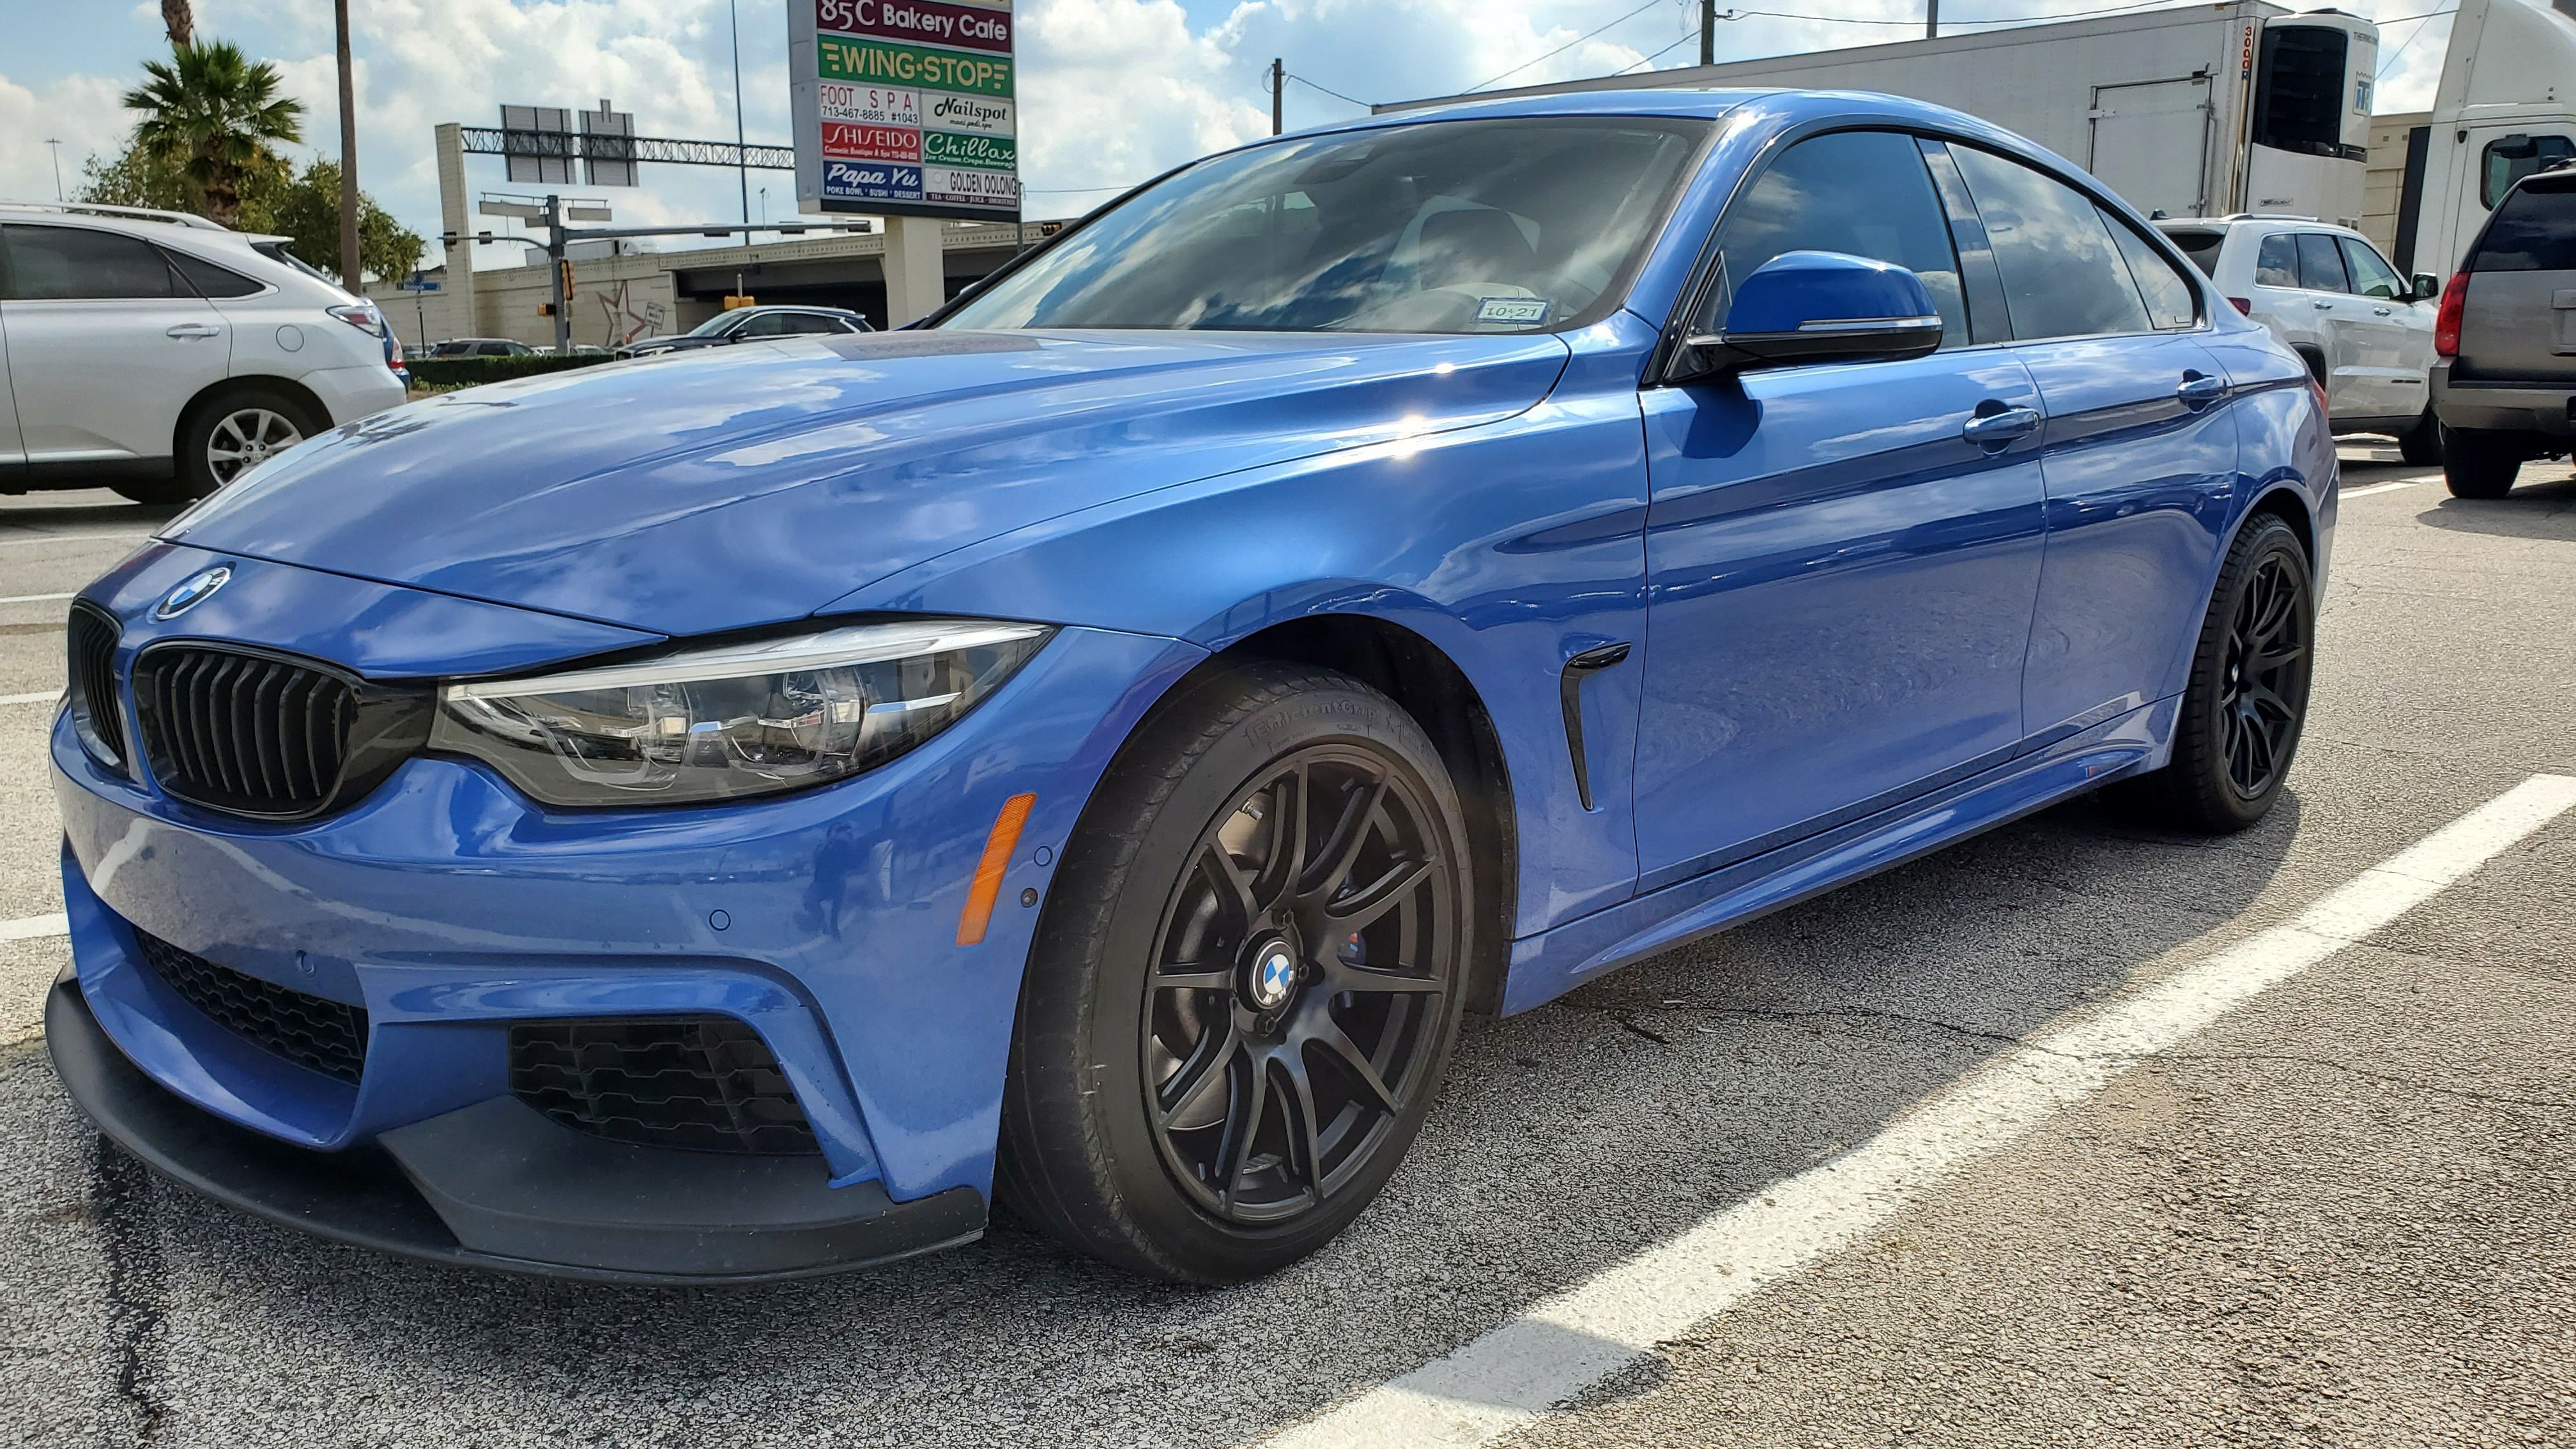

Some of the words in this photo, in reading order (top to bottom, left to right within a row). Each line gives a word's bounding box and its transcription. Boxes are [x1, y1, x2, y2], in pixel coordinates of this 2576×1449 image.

[820, 0, 875, 29] 85C
[883, 3, 954, 38] Bakery
[958, 14, 1008, 41] Cafe
[820, 85, 854, 107] FOOT
[822, 105, 885, 121] 713-467-8885
[891, 112, 918, 124] #1043
[934, 97, 1007, 121] Nailspot
[824, 125, 917, 148] SHISEIDO
[924, 133, 1016, 160] Chillax
[827, 163, 887, 187] Papa
[891, 167, 919, 187] Yu
[950, 172, 982, 193] GOLDEN
[985, 174, 1016, 195] OOLONG
[826, 186, 844, 194] POKE
[845, 187, 863, 195] BOWL
